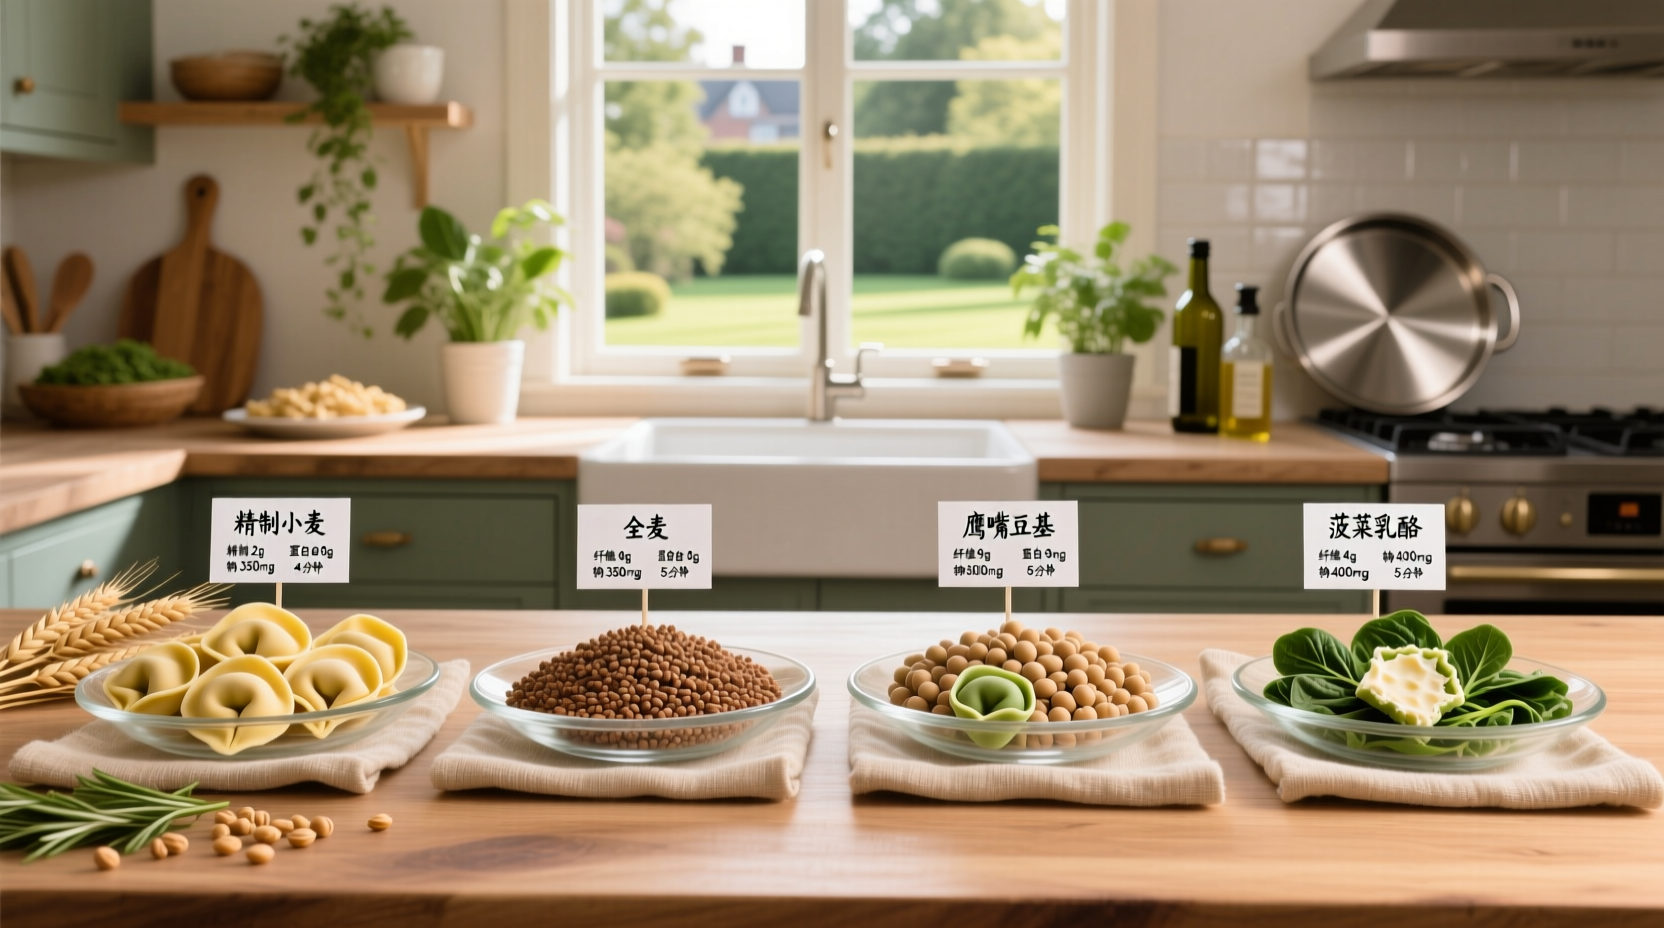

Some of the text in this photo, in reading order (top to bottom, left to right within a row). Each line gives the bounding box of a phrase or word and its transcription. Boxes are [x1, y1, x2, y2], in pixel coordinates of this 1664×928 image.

[234, 509, 325, 536] 精制小麦
[624, 514, 668, 540] 全麦
[963, 511, 1055, 540] 鹰嘴豆基
[1329, 512, 1422, 539] 菠菜乳酪
